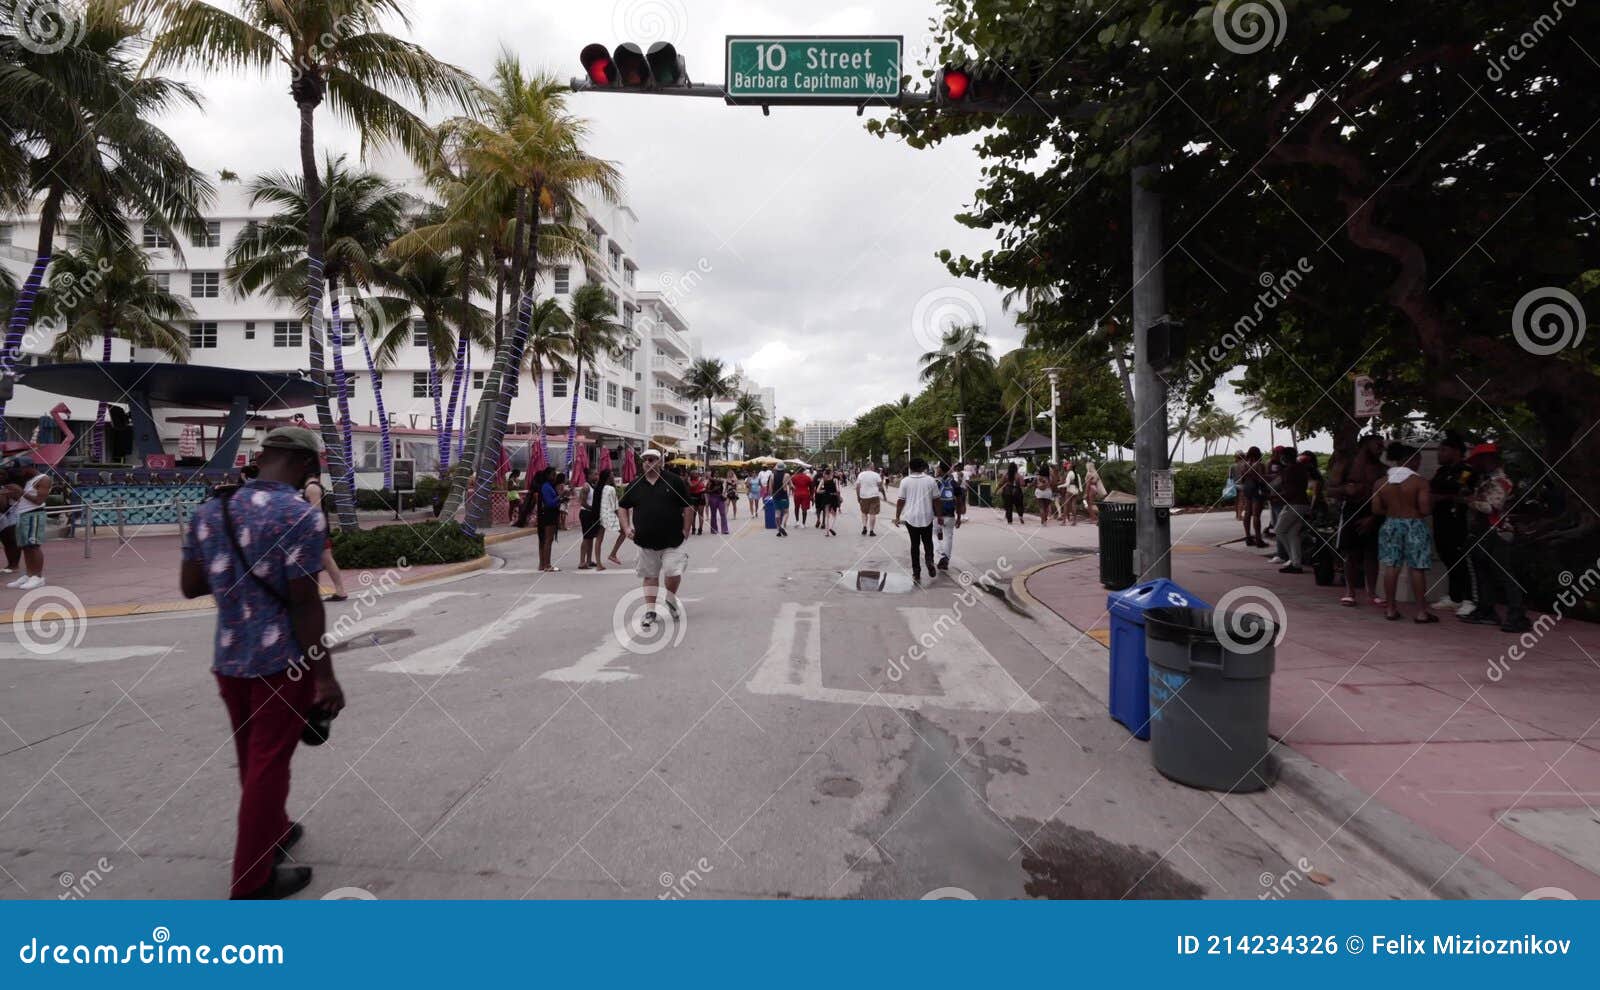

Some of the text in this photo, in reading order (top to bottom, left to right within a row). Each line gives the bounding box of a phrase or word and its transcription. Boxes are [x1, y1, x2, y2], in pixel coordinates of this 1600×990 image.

[755, 44, 787, 71] 10
[806, 47, 872, 69] Street
[735, 72, 893, 92] Barbara Capitman Way
